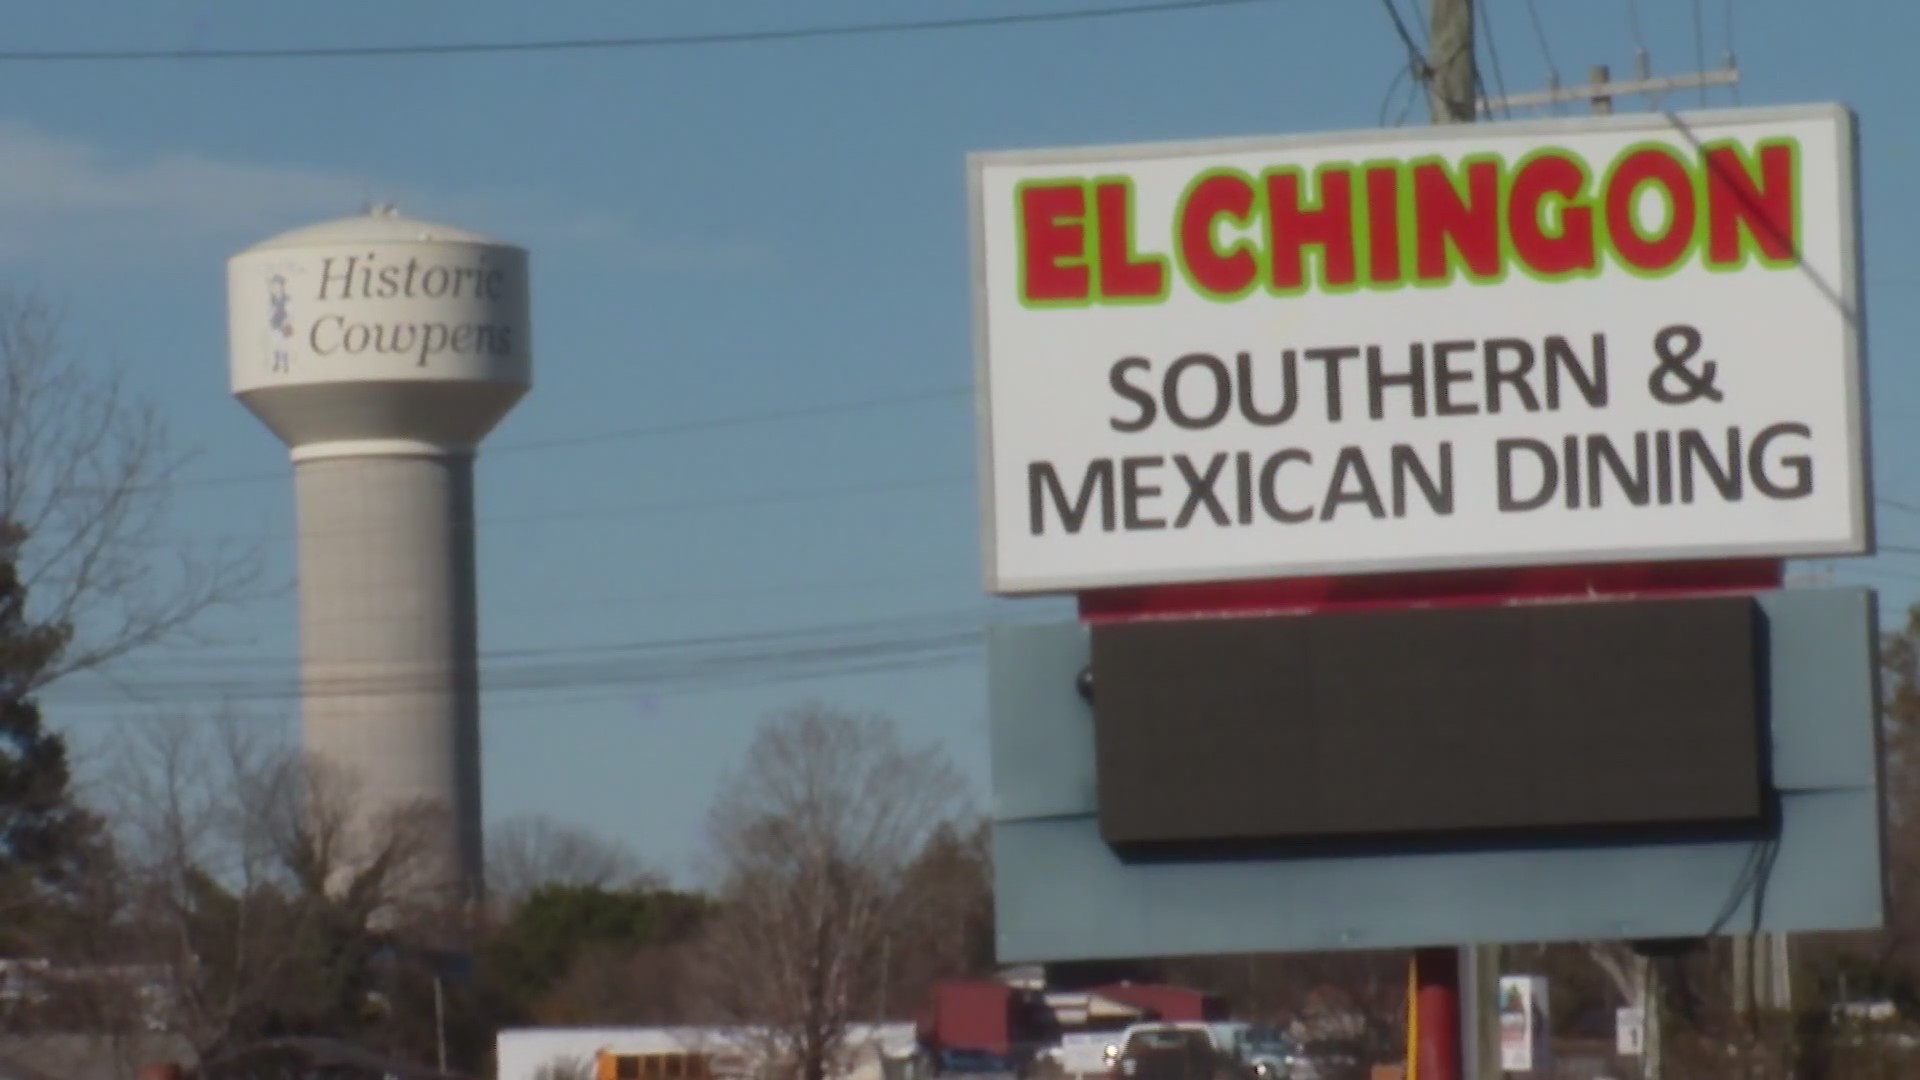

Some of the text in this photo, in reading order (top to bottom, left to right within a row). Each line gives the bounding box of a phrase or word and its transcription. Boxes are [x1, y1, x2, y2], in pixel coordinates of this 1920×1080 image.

[317, 252, 503, 302] Historic
[1018, 140, 1798, 305] EL CHINGON
[308, 312, 512, 368] Cowpens
[1109, 324, 1724, 434] SOUTHERN &
[1028, 423, 1813, 536] MEXICAN DINING
